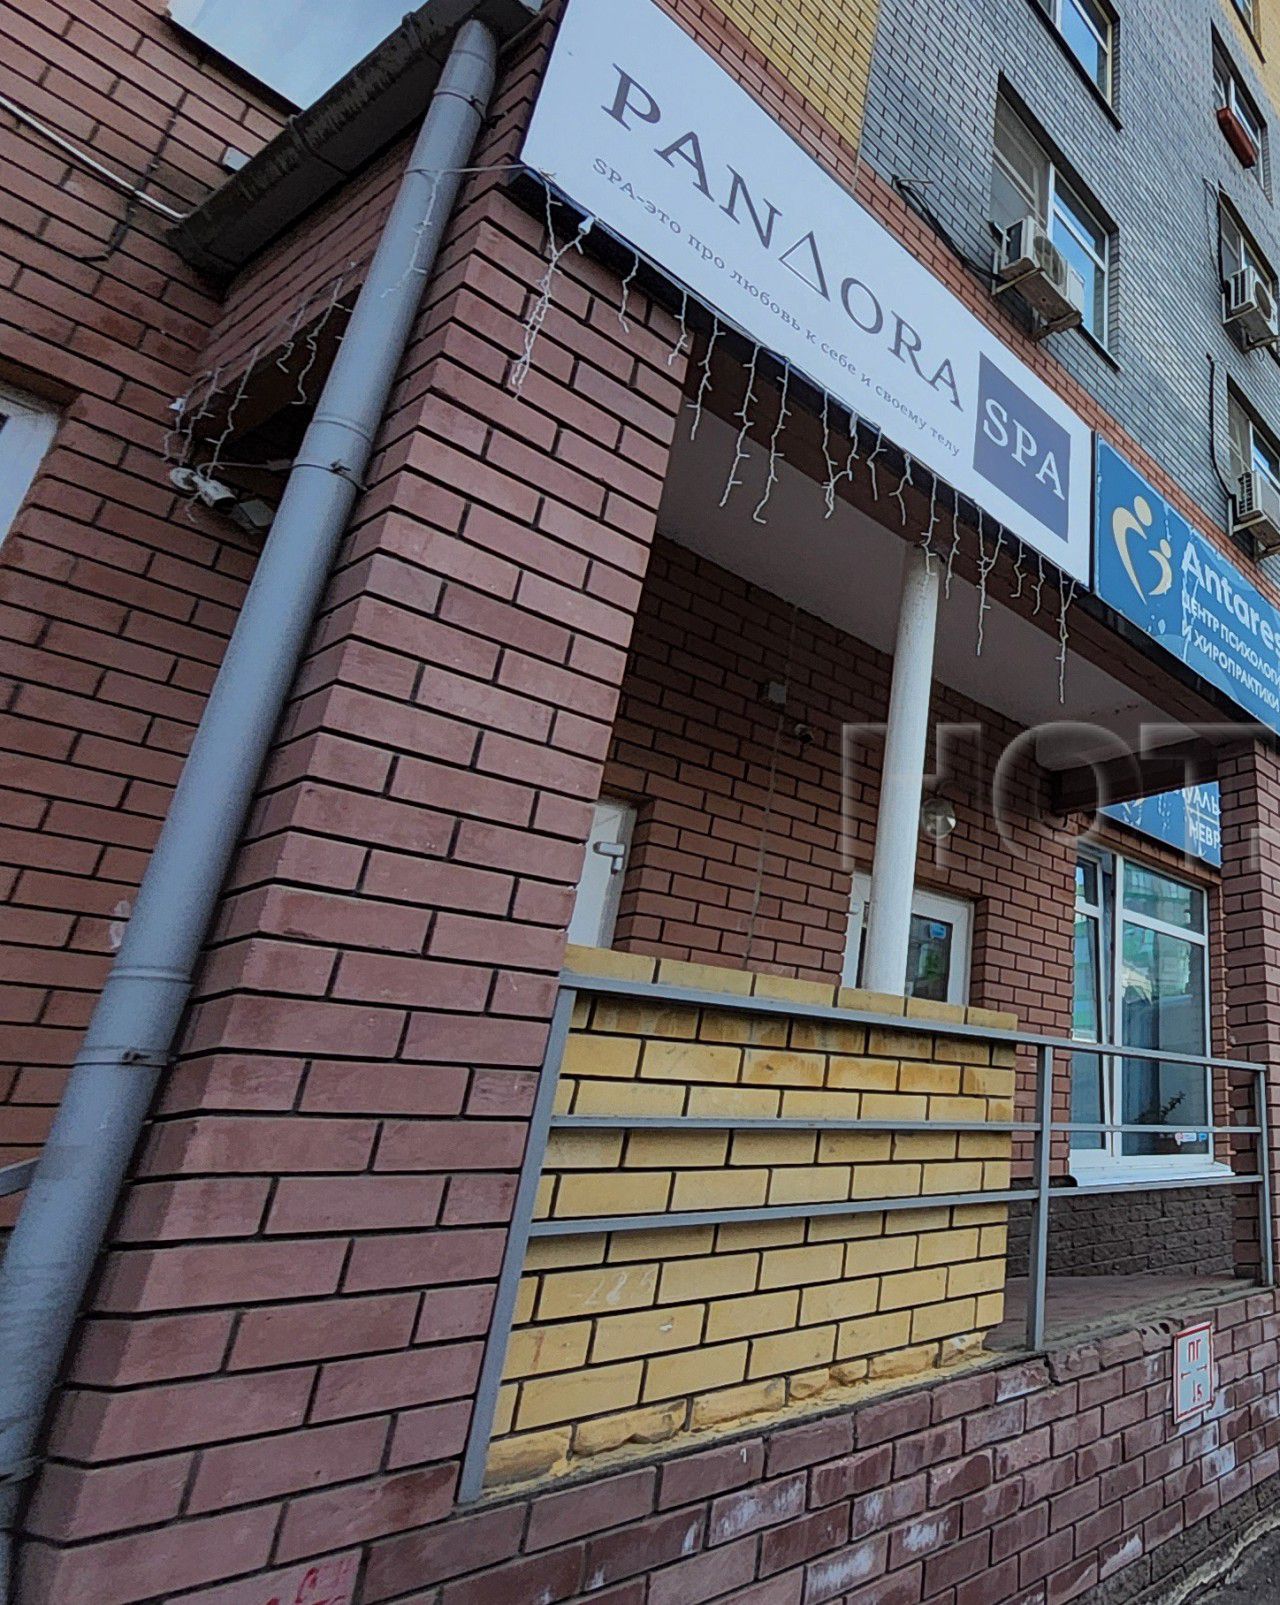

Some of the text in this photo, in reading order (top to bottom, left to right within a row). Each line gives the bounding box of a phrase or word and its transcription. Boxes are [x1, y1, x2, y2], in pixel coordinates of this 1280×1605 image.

[687, 234, 726, 270] про
[729, 270, 801, 331] любовь
[805, 330, 818, 347] к
[821, 341, 858, 377] себе
[861, 373, 873, 388] и
[875, 384, 927, 431] своему
[929, 427, 961, 458] телу
[982, 398, 1066, 502] SPA
[1183, 592, 1220, 633] ЦЕНТР
[1182, 619, 1280, 713] И ХИРОПРАКТИКИ
[1187, 1338, 1202, 1363] ПГ
